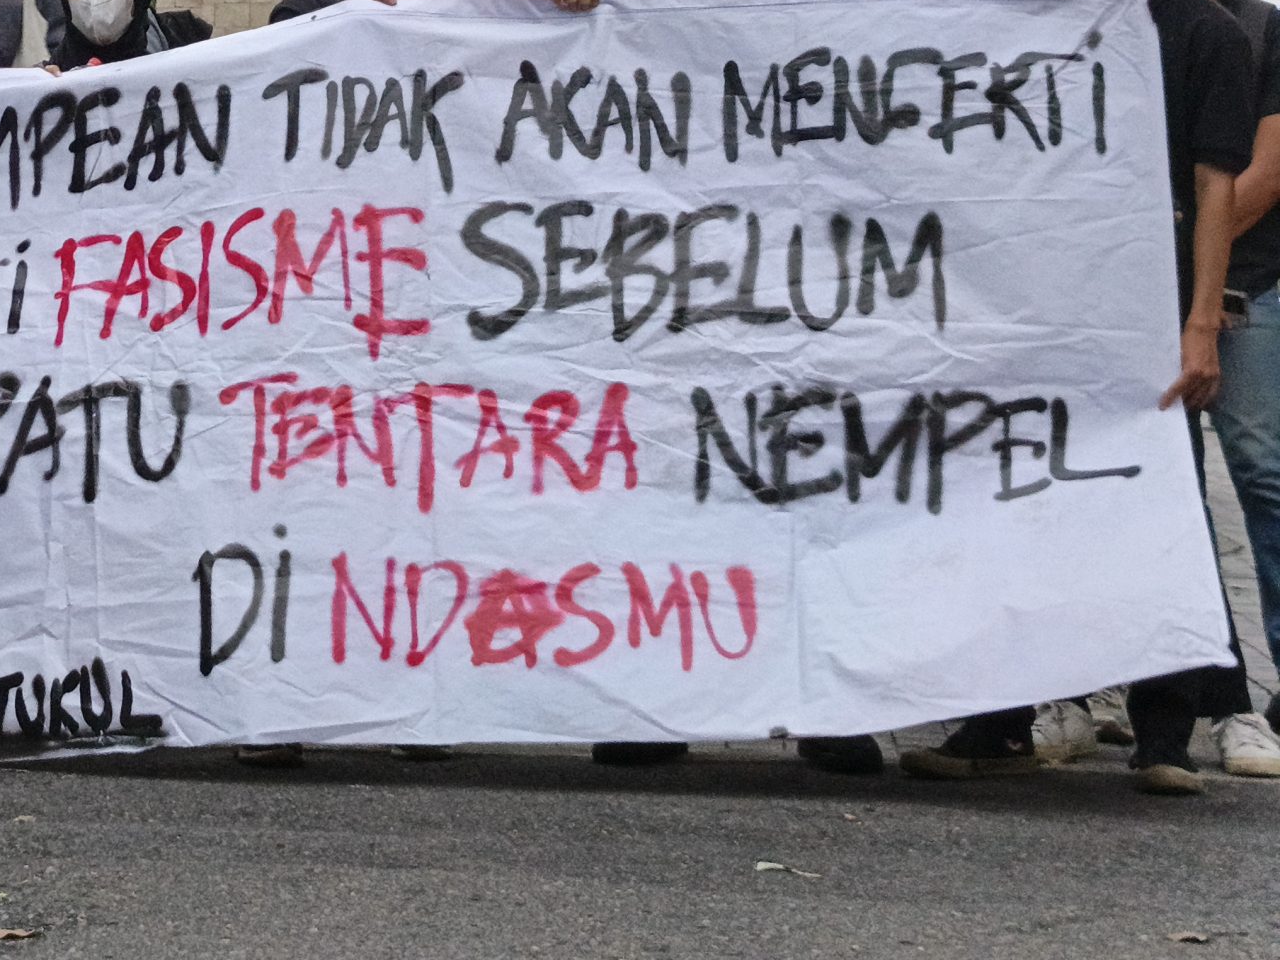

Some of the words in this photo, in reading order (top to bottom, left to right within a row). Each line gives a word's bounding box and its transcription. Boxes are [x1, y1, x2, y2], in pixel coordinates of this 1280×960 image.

[262, 68, 466, 195] TIDAK
[494, 58, 692, 172] AKAN
[53, 202, 430, 362] FASISME
[460, 200, 947, 342] SEBELUM
[219, 371, 640, 514] TENTARA
[689, 381, 1143, 516] NEMPEL
[330, 551, 758, 674] NDASMU
